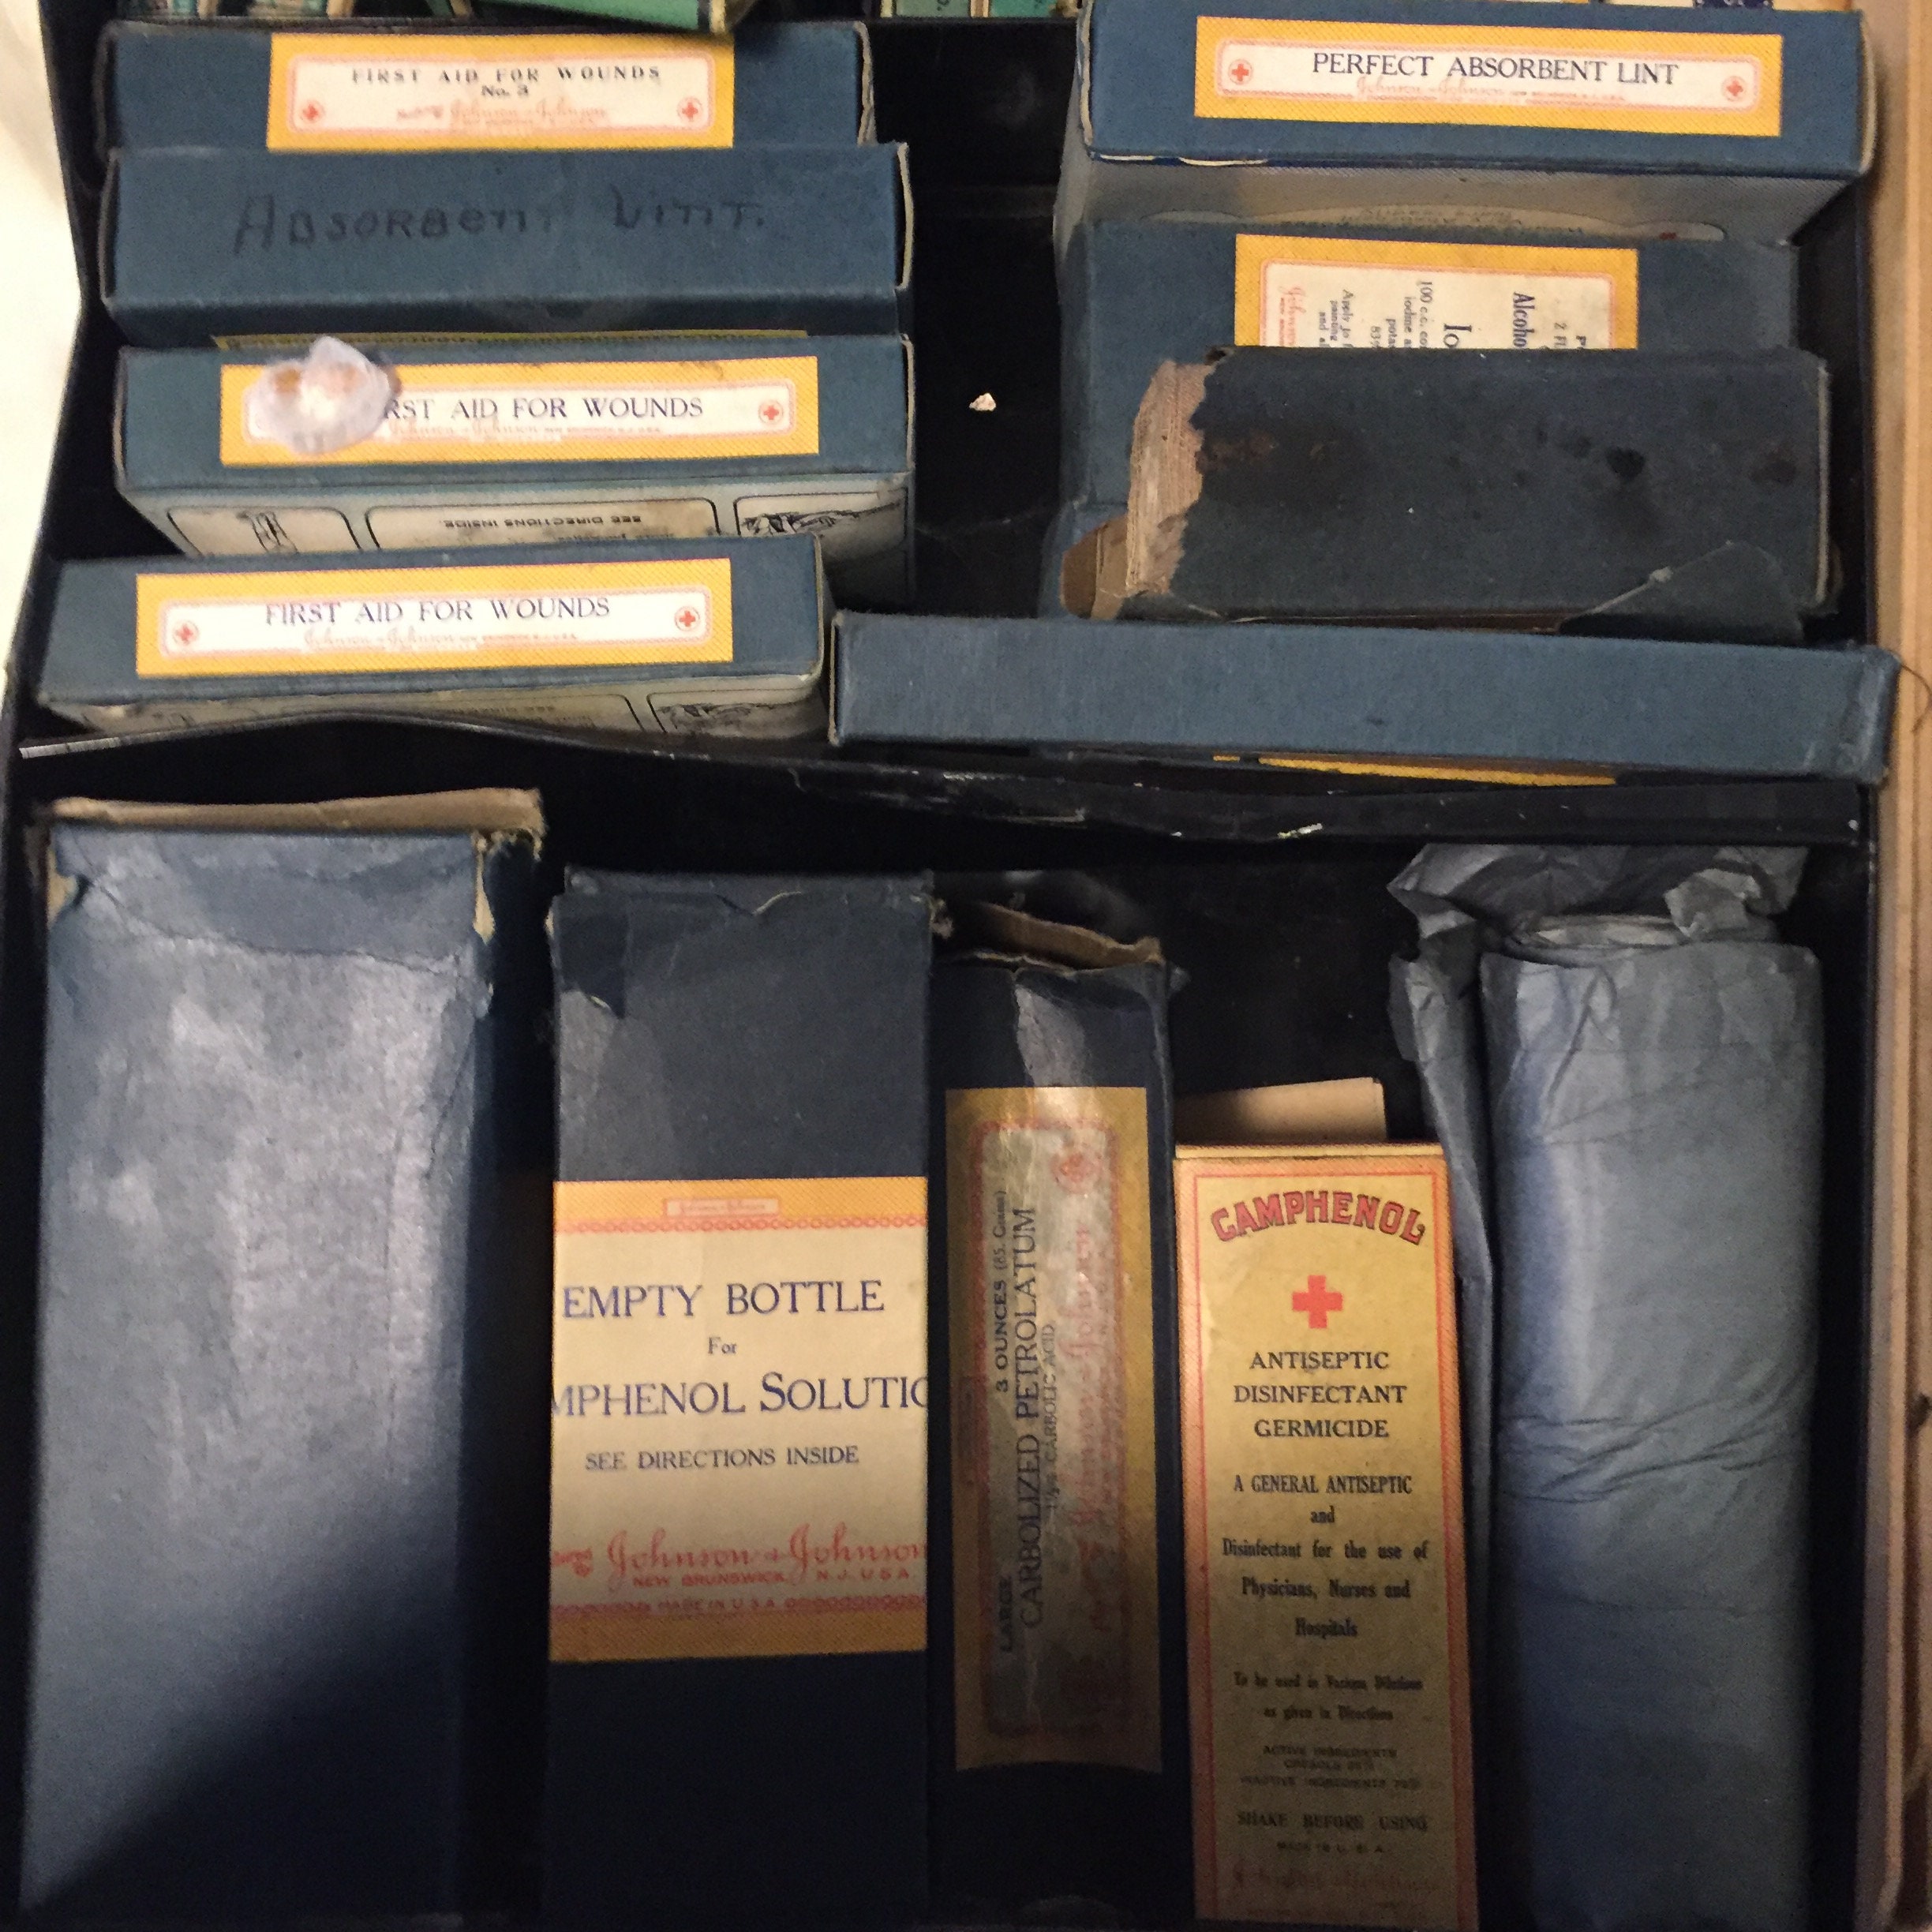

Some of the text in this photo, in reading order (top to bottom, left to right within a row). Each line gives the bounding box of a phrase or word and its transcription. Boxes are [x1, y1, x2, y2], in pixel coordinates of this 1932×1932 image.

[352, 65, 661, 84] FIRST AID FOR WOUNDS
[1312, 52, 1680, 85] PERFECT ABSORBENT LINT
[1419, 281, 1433, 303] 100
[383, 395, 704, 421] RST AID FOR WOUNDS
[265, 597, 611, 626] FIRST AID FOR WOUNDS
[1211, 1190, 1426, 1245] CAMPHENOL
[562, 1279, 885, 1320] EMPTY BOTTLE
[992, 1279, 1009, 1371] OUNCES
[707, 1336, 737, 1355] For
[1249, 1351, 1391, 1371] ANTISEPTIC
[994, 1379, 1009, 1393] 3
[1234, 1385, 1408, 1404] DISINFECTANT
[1011, 1207, 1043, 1627] CARBOLIZED PETROLATUM
[1042, 1374, 1058, 1462] CARBOLIC
[1253, 1419, 1390, 1438] GERMICIDE
[585, 1444, 859, 1472] SEE DIRECTIONS INSIDE
[1234, 1474, 1413, 1495] A GENERAL ANTISEPTIC
[1310, 1505, 1336, 1524] and
[1222, 1537, 1429, 1561] Disinfectant for the use of
[1241, 1575, 1412, 1601] Physicians, Nurses and
[1294, 1616, 1359, 1640] Hospitals
